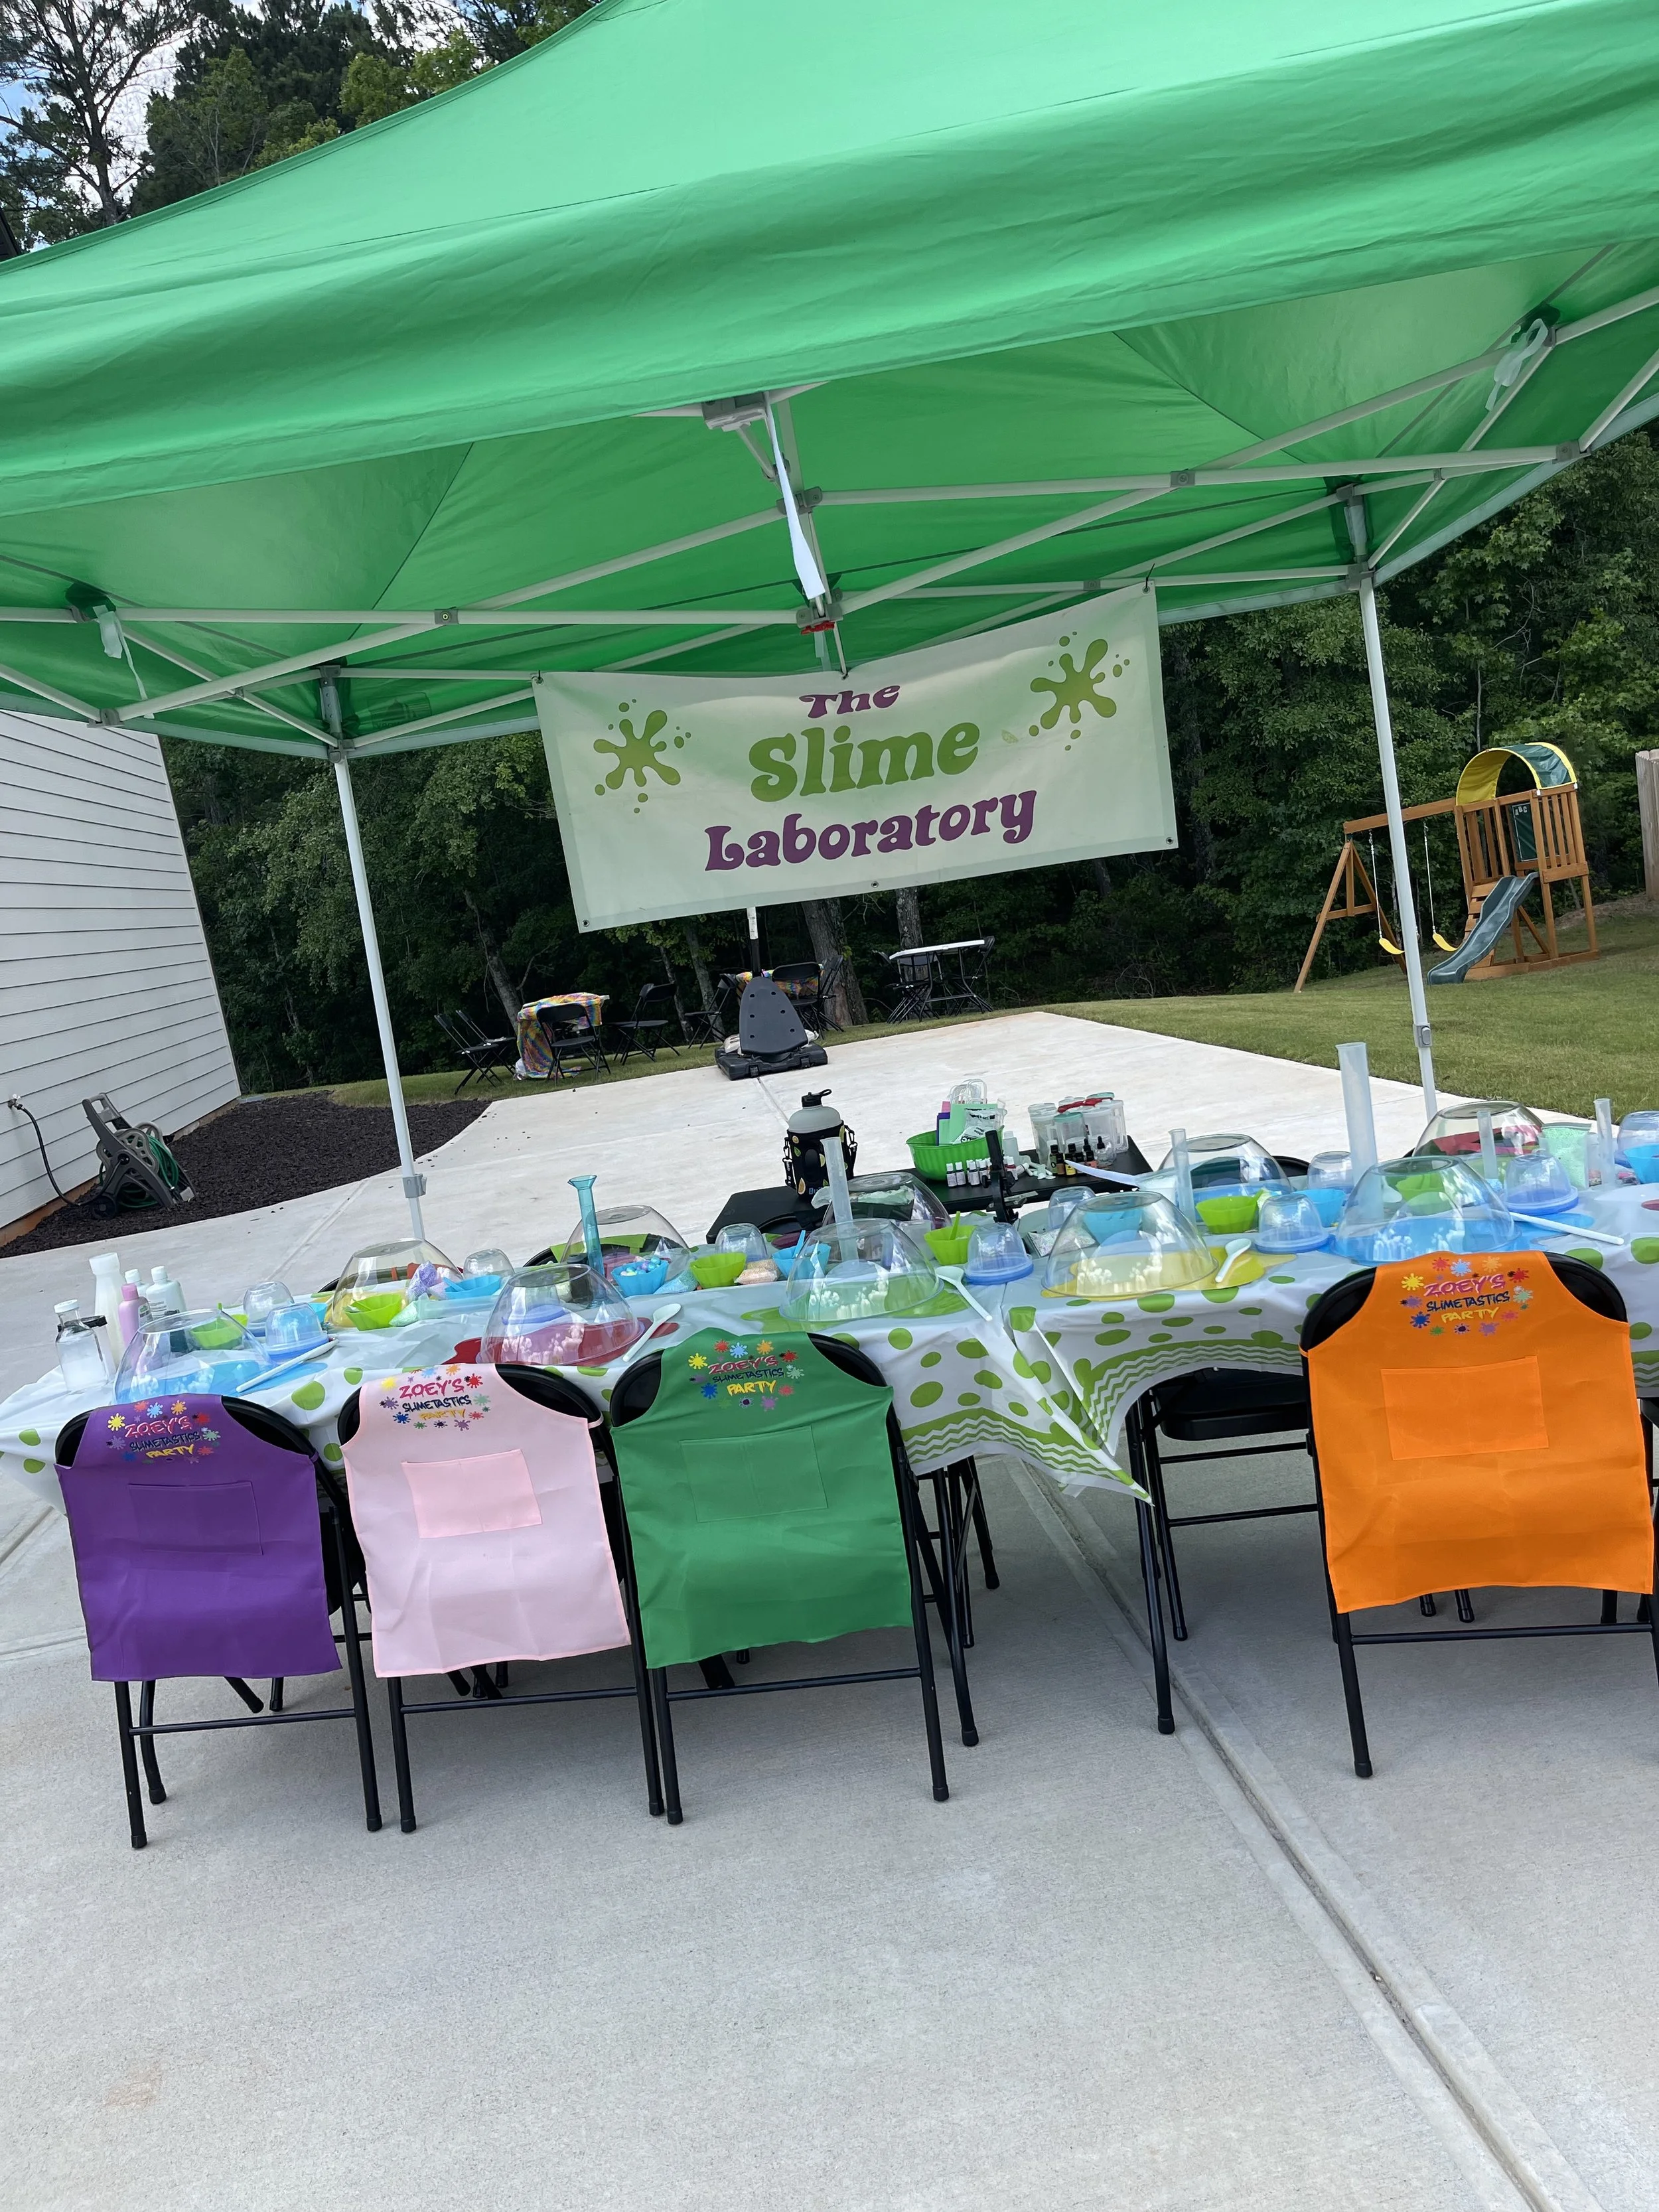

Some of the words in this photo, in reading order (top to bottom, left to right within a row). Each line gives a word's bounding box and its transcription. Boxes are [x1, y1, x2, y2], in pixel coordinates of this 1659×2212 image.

[798, 685, 901, 719] The
[748, 721, 981, 803] Slime
[1514, 806, 1528, 816] ABC
[704, 790, 1038, 871] Laboratory
[1423, 1273, 1506, 1297] ZOEY'S
[1441, 1306, 1500, 1324] PARTY
[707, 1355, 779, 1375] ZOEY'S
[399, 1378, 465, 1399] ZOEY'S
[726, 1380, 777, 1396] PARTY
[418, 1408, 466, 1421] PARTY
[125, 1416, 192, 1439] ZOEY'S
[145, 1443, 194, 1459] PARTY
